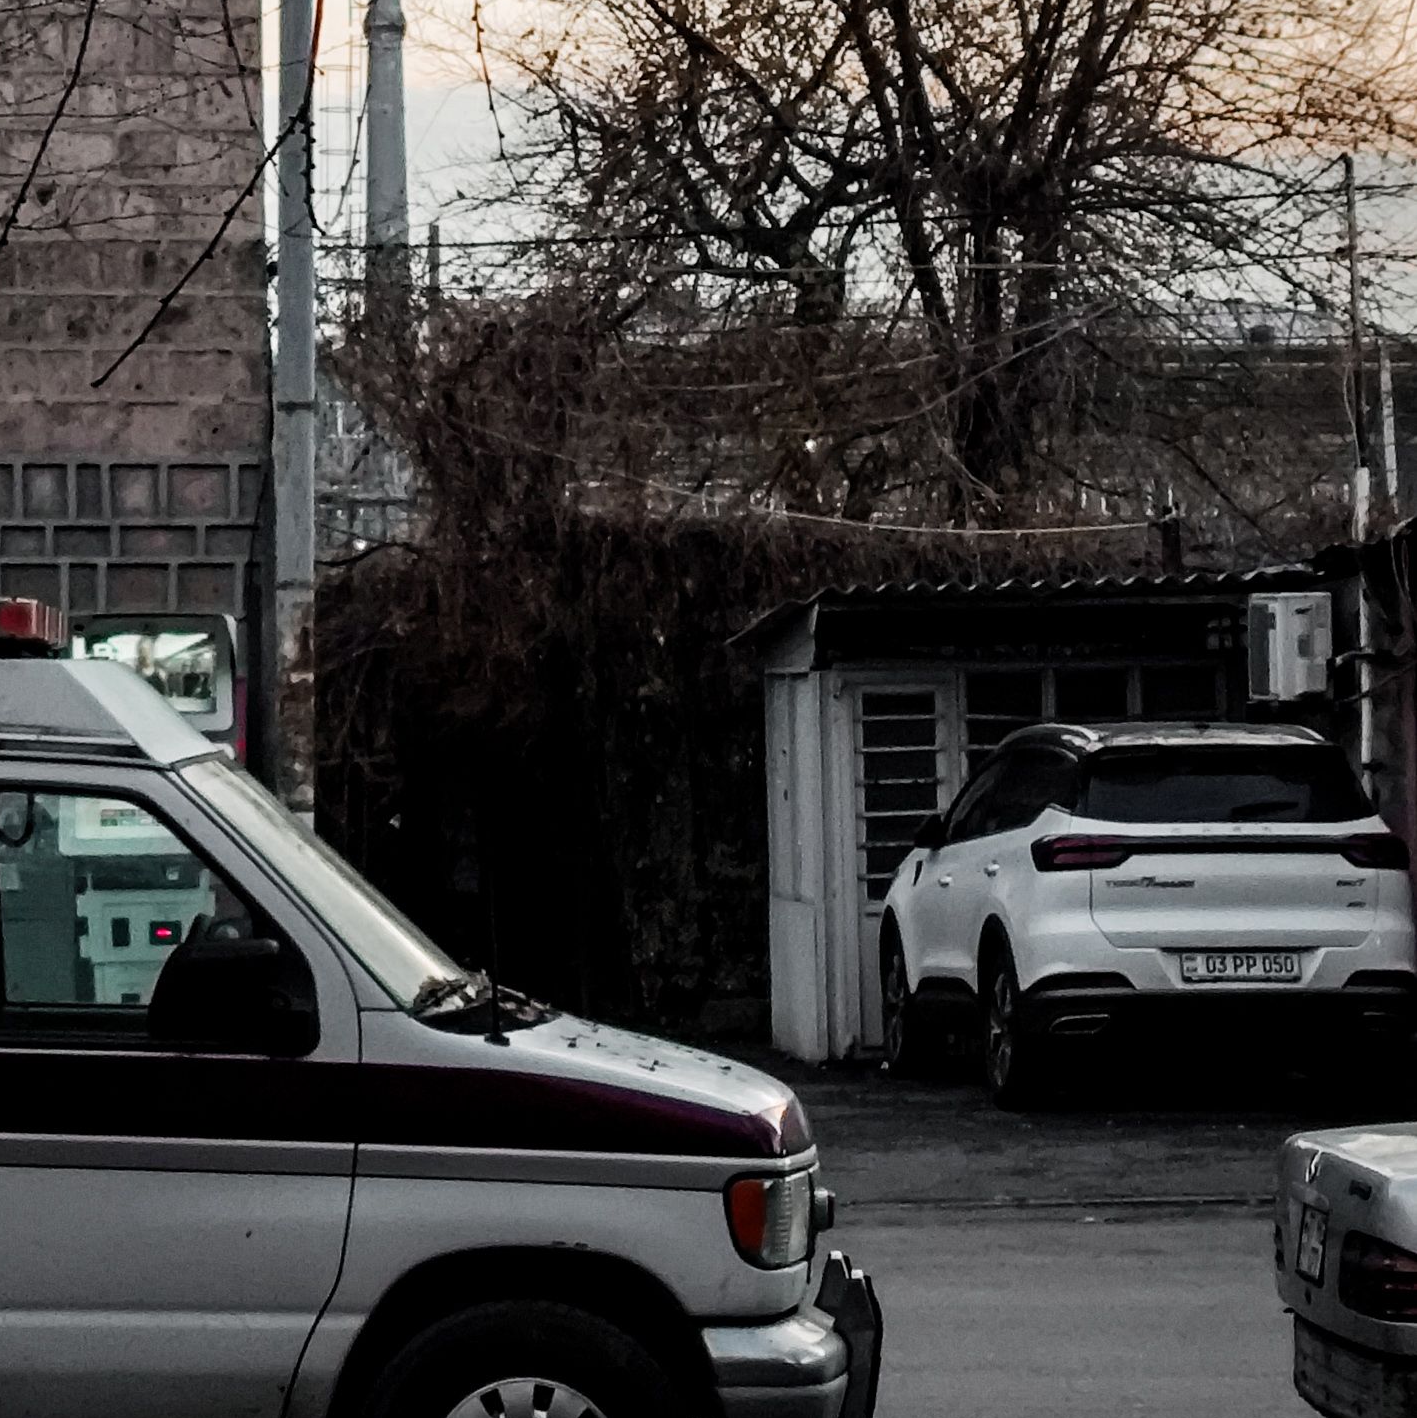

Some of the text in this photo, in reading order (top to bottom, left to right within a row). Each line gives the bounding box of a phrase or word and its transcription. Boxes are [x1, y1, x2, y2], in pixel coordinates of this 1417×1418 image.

[1205, 955, 1294, 973] 03 PP 050
